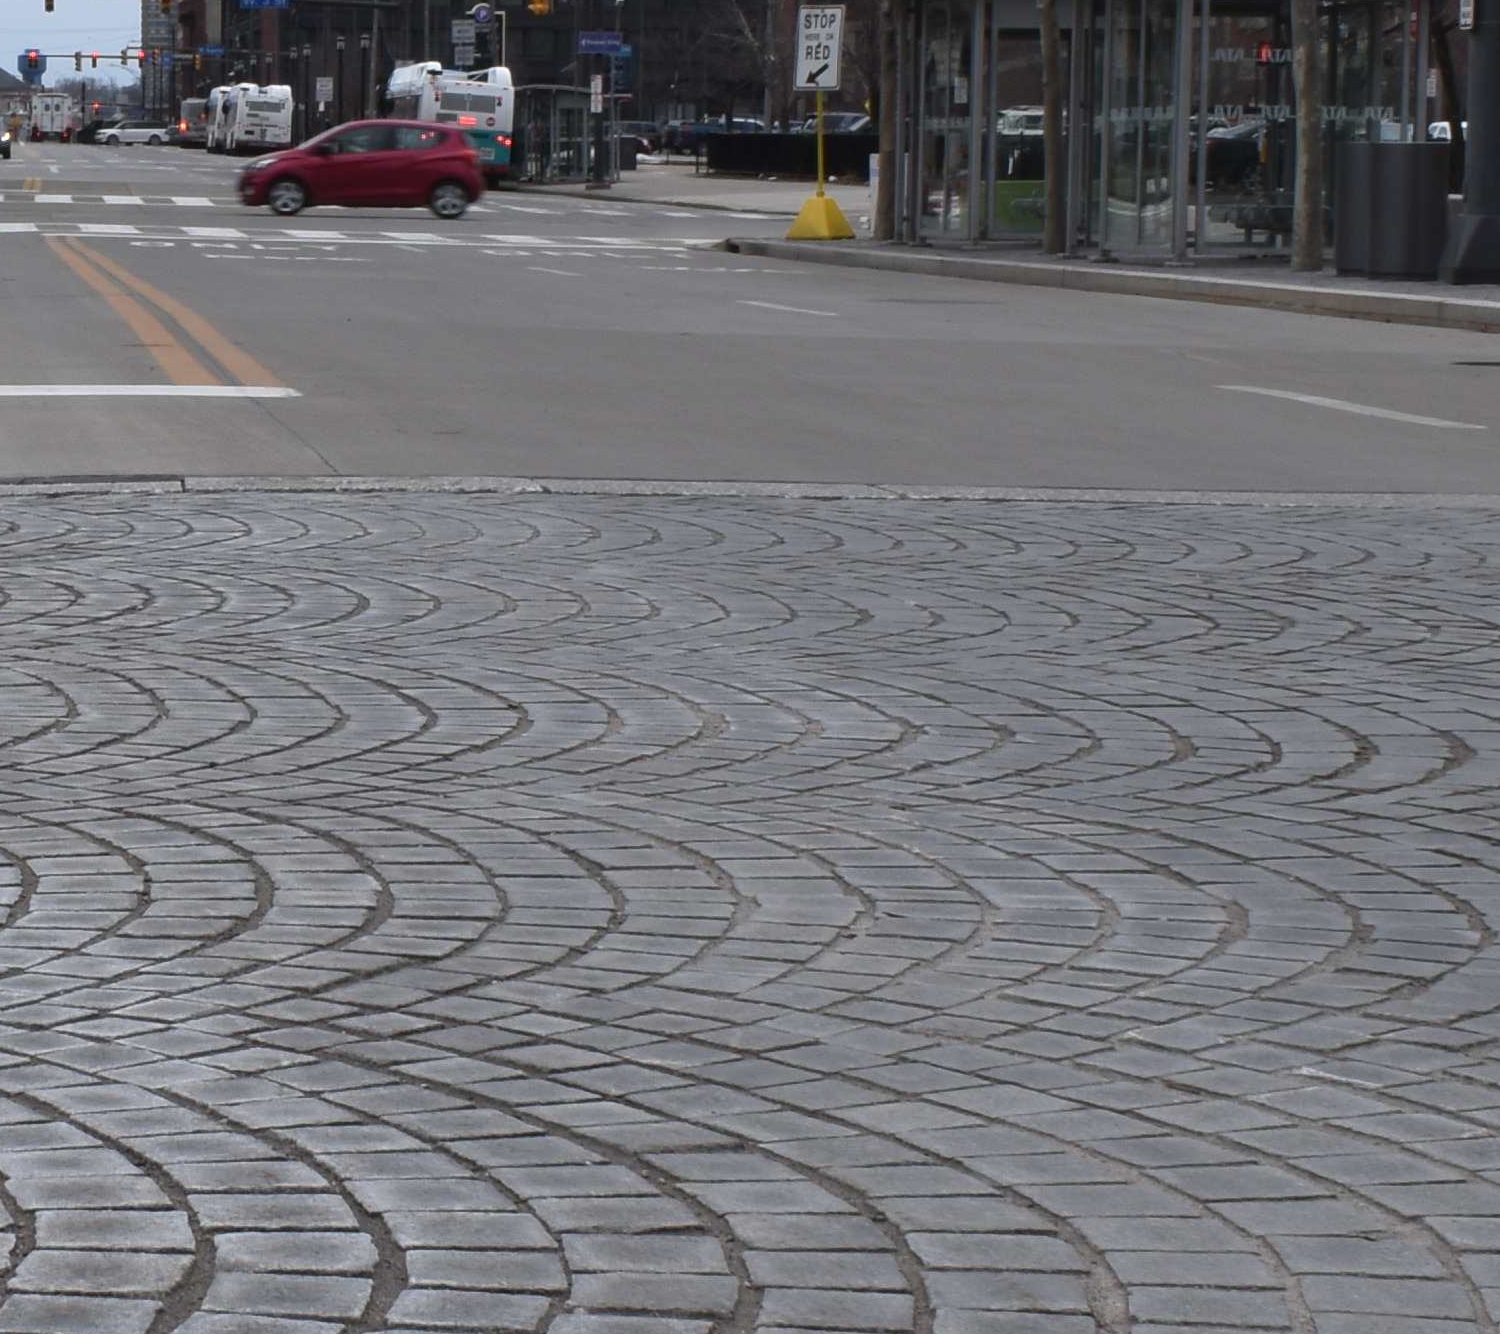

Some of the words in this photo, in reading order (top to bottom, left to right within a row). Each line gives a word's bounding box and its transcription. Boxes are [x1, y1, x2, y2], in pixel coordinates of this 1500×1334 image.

[804, 13, 836, 29] STOP
[804, 33, 820, 41] HERE
[825, 32, 834, 41] ON
[805, 44, 831, 60] RED
